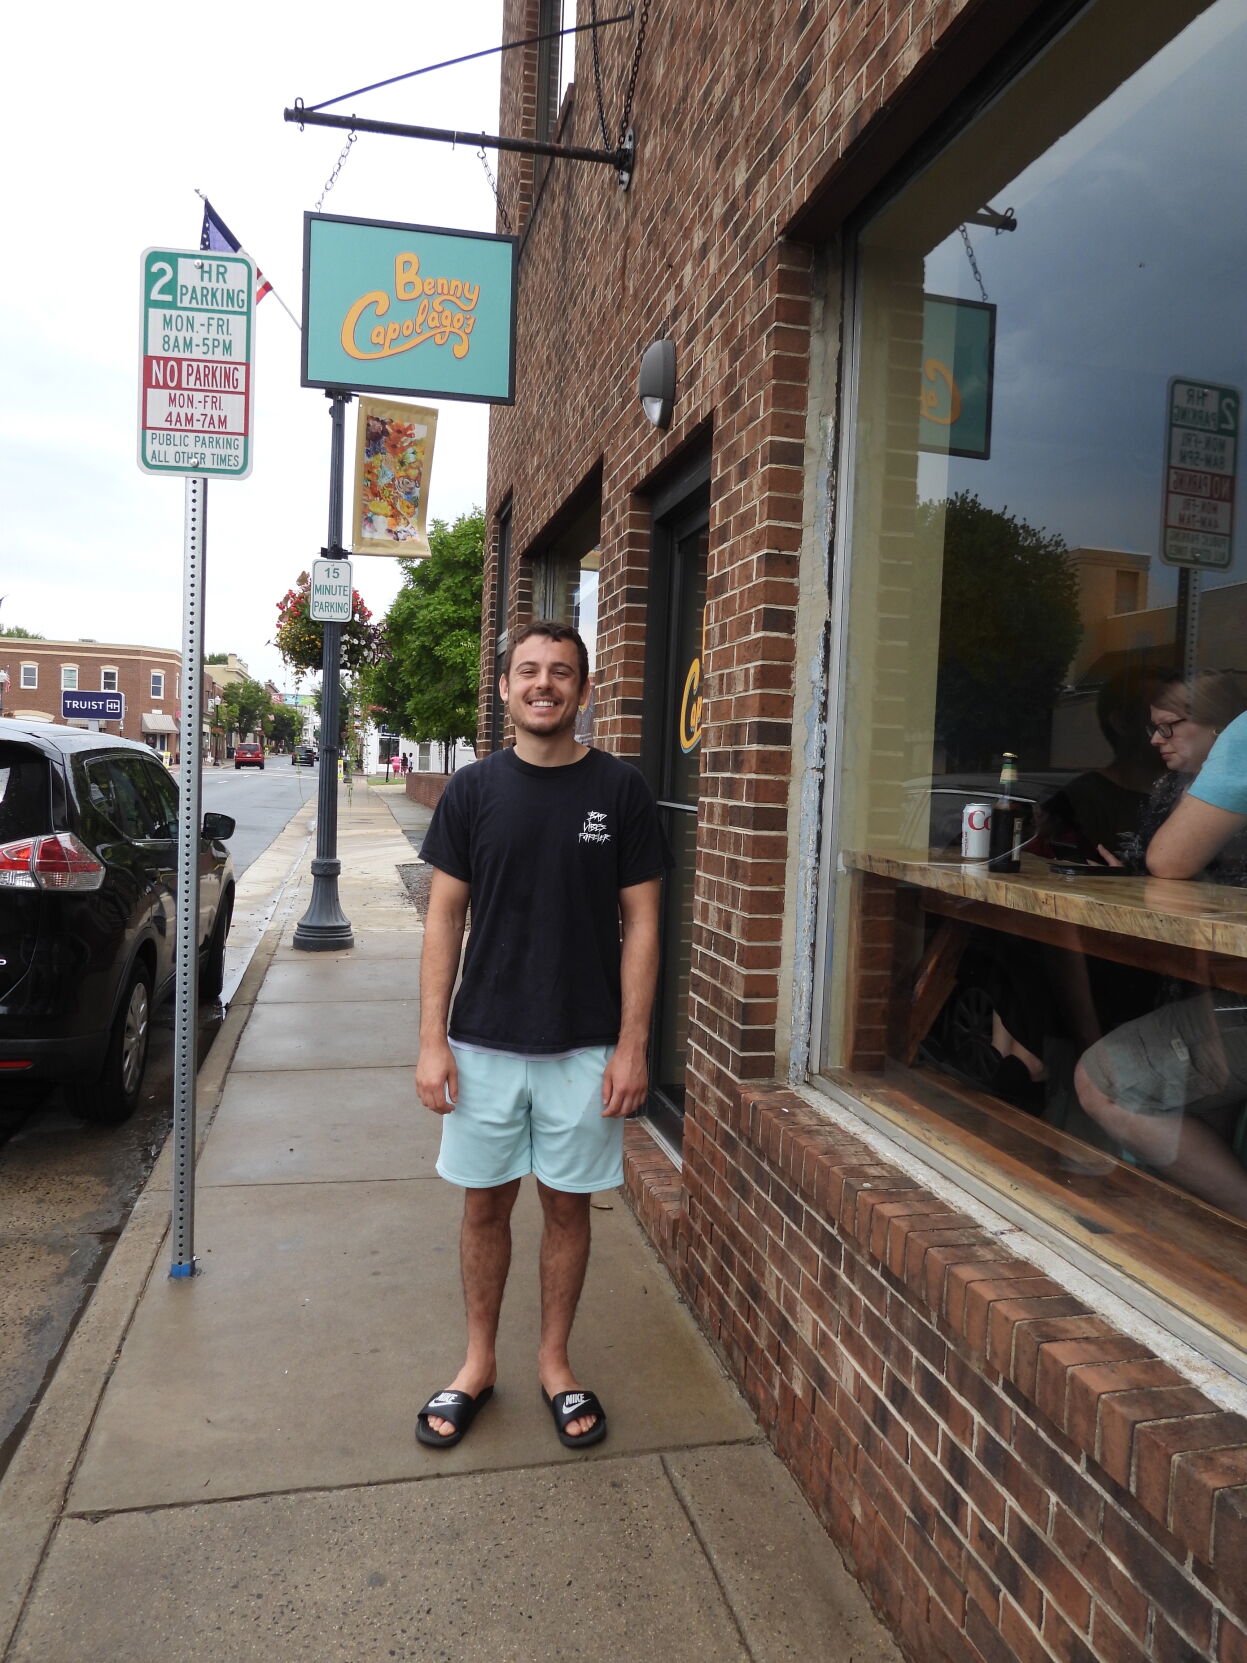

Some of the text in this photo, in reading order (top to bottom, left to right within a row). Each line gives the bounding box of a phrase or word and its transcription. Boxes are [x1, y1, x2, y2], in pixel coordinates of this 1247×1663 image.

[150, 261, 228, 302] 2 HR
[395, 252, 480, 312] Benny
[179, 284, 245, 310] PARKING
[162, 335, 233, 357] 8AM-5PM
[152, 359, 239, 390] NO PARKING
[164, 411, 228, 430] 4AM-7AM
[151, 432, 239, 451] PUBLIC PARKING
[150, 450, 170, 464] ALL
[211, 453, 239, 468] TIMES
[324, 567, 340, 579] 15
[314, 583, 349, 597] MINUTE
[313, 601, 349, 614] PARKING
[64, 700, 104, 710] TRUIST
[565, 1393, 585, 1406] NIKE
